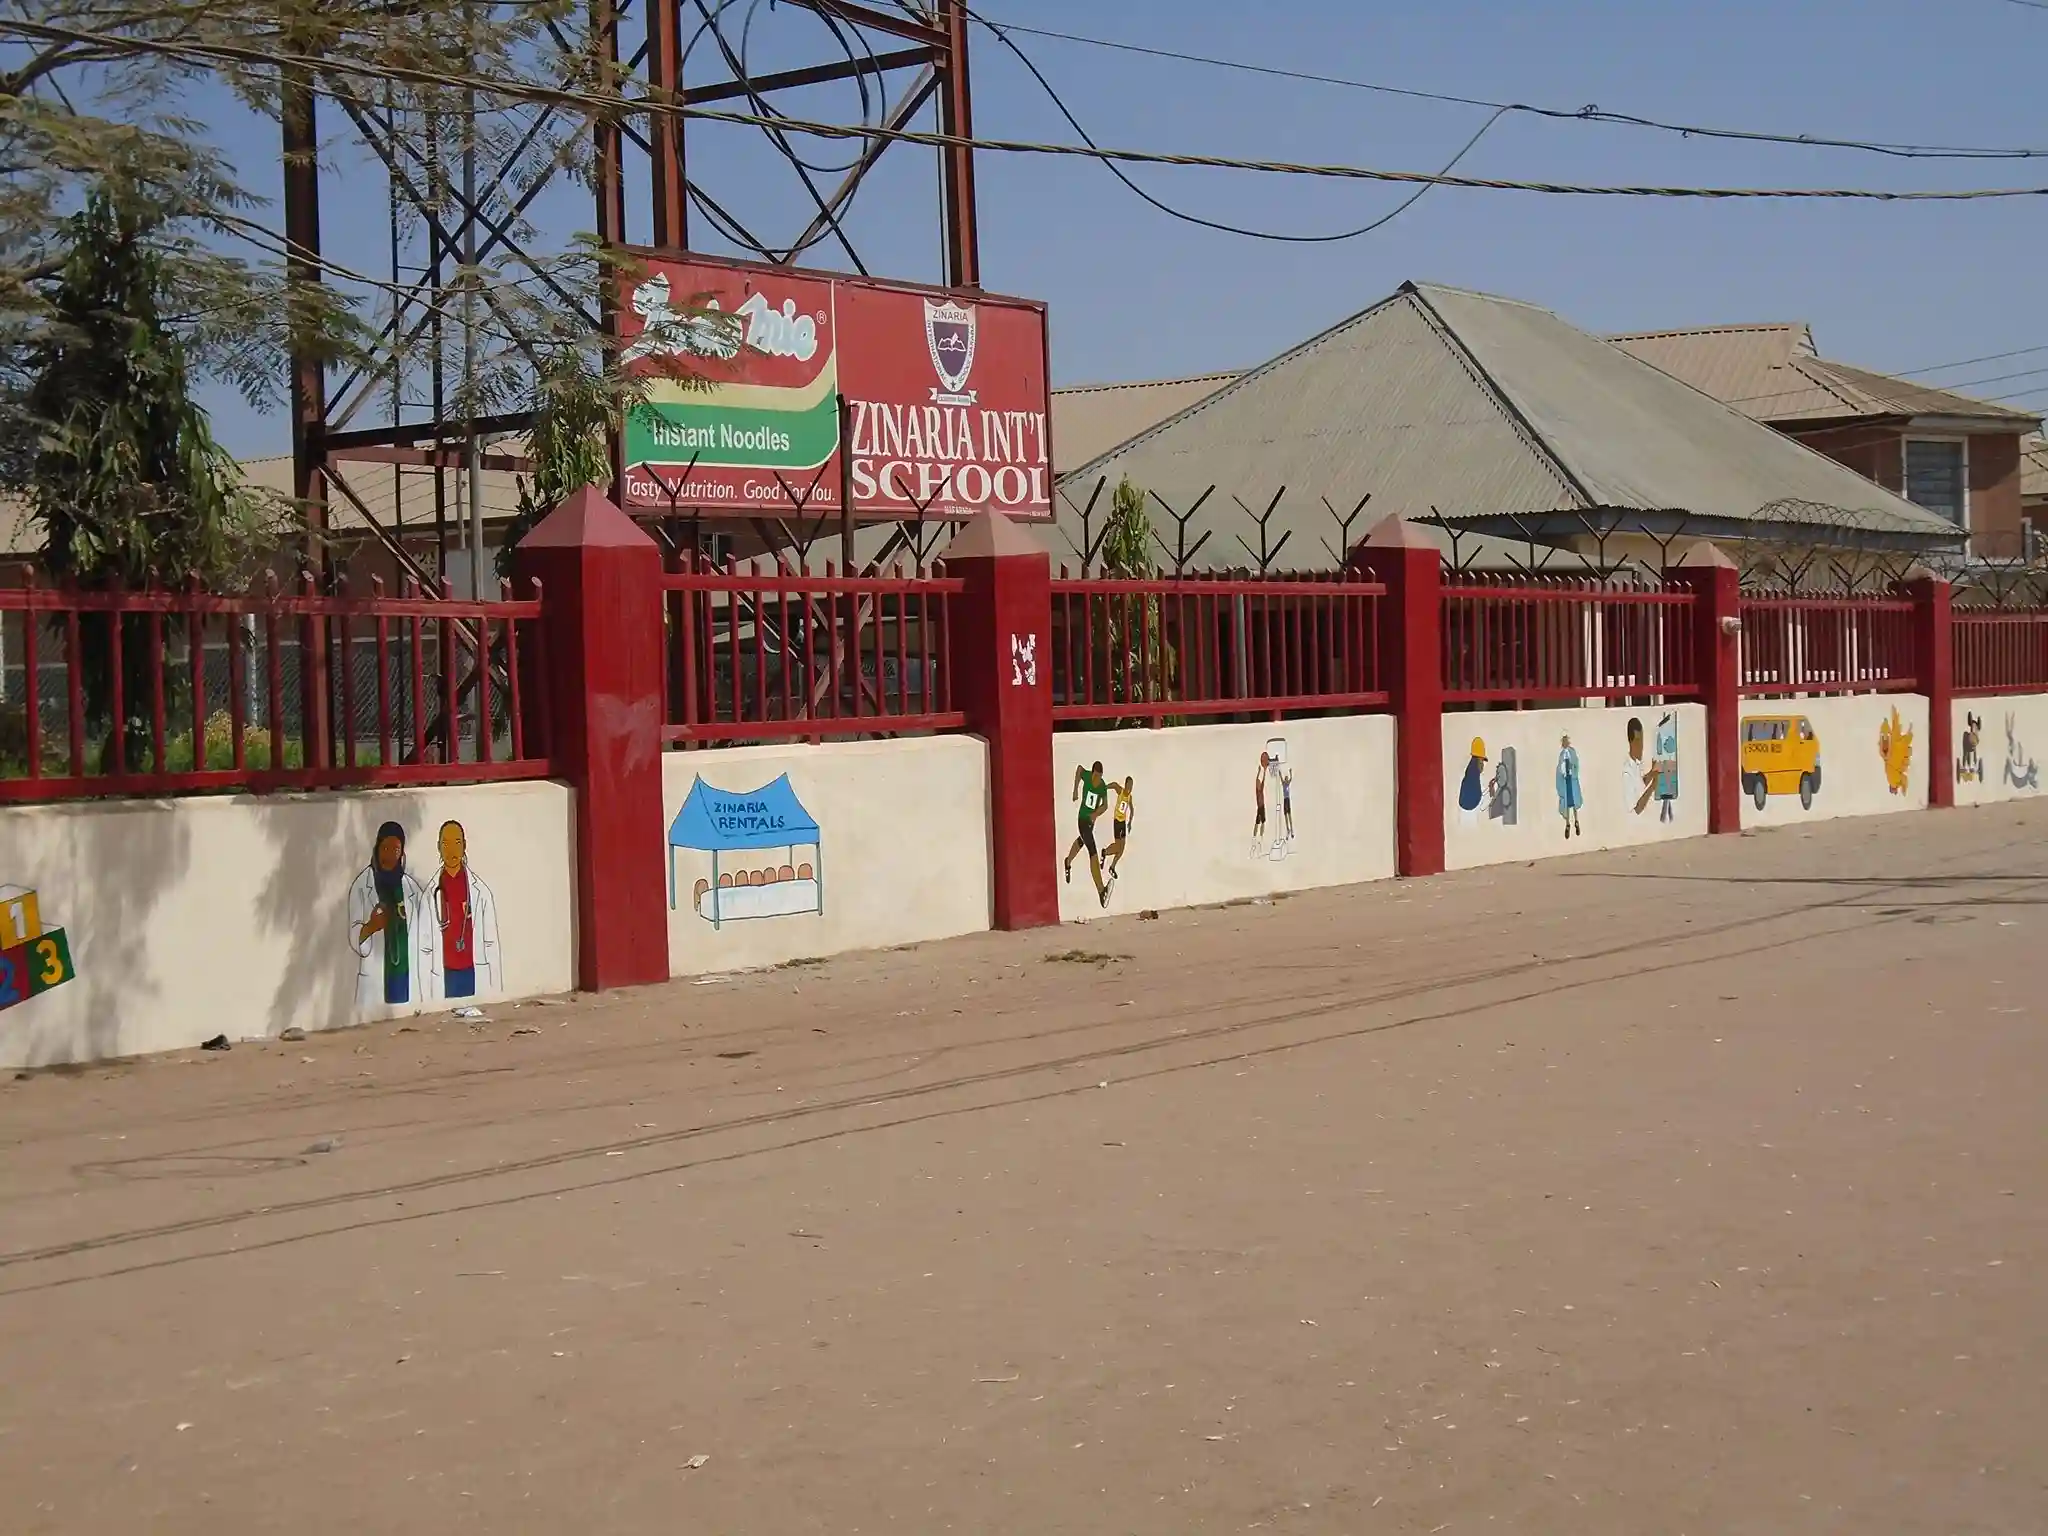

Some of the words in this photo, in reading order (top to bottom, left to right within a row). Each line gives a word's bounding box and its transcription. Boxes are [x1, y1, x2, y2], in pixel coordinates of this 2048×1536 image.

[619, 272, 818, 361] Iomie
[932, 309, 969, 322] ZINARIA
[653, 420, 715, 447] Instant
[720, 424, 790, 450] Noodles
[850, 400, 977, 461] ZINARIA
[625, 474, 662, 500] Tasty
[668, 477, 738, 499] Nutrition.
[744, 480, 780, 500] Good
[852, 459, 1051, 505] SCHOOL
[714, 801, 769, 813] ZINARIA
[718, 816, 785, 830] RENTALS
[9, 902, 28, 939] 1
[36, 939, 64, 985] 3
